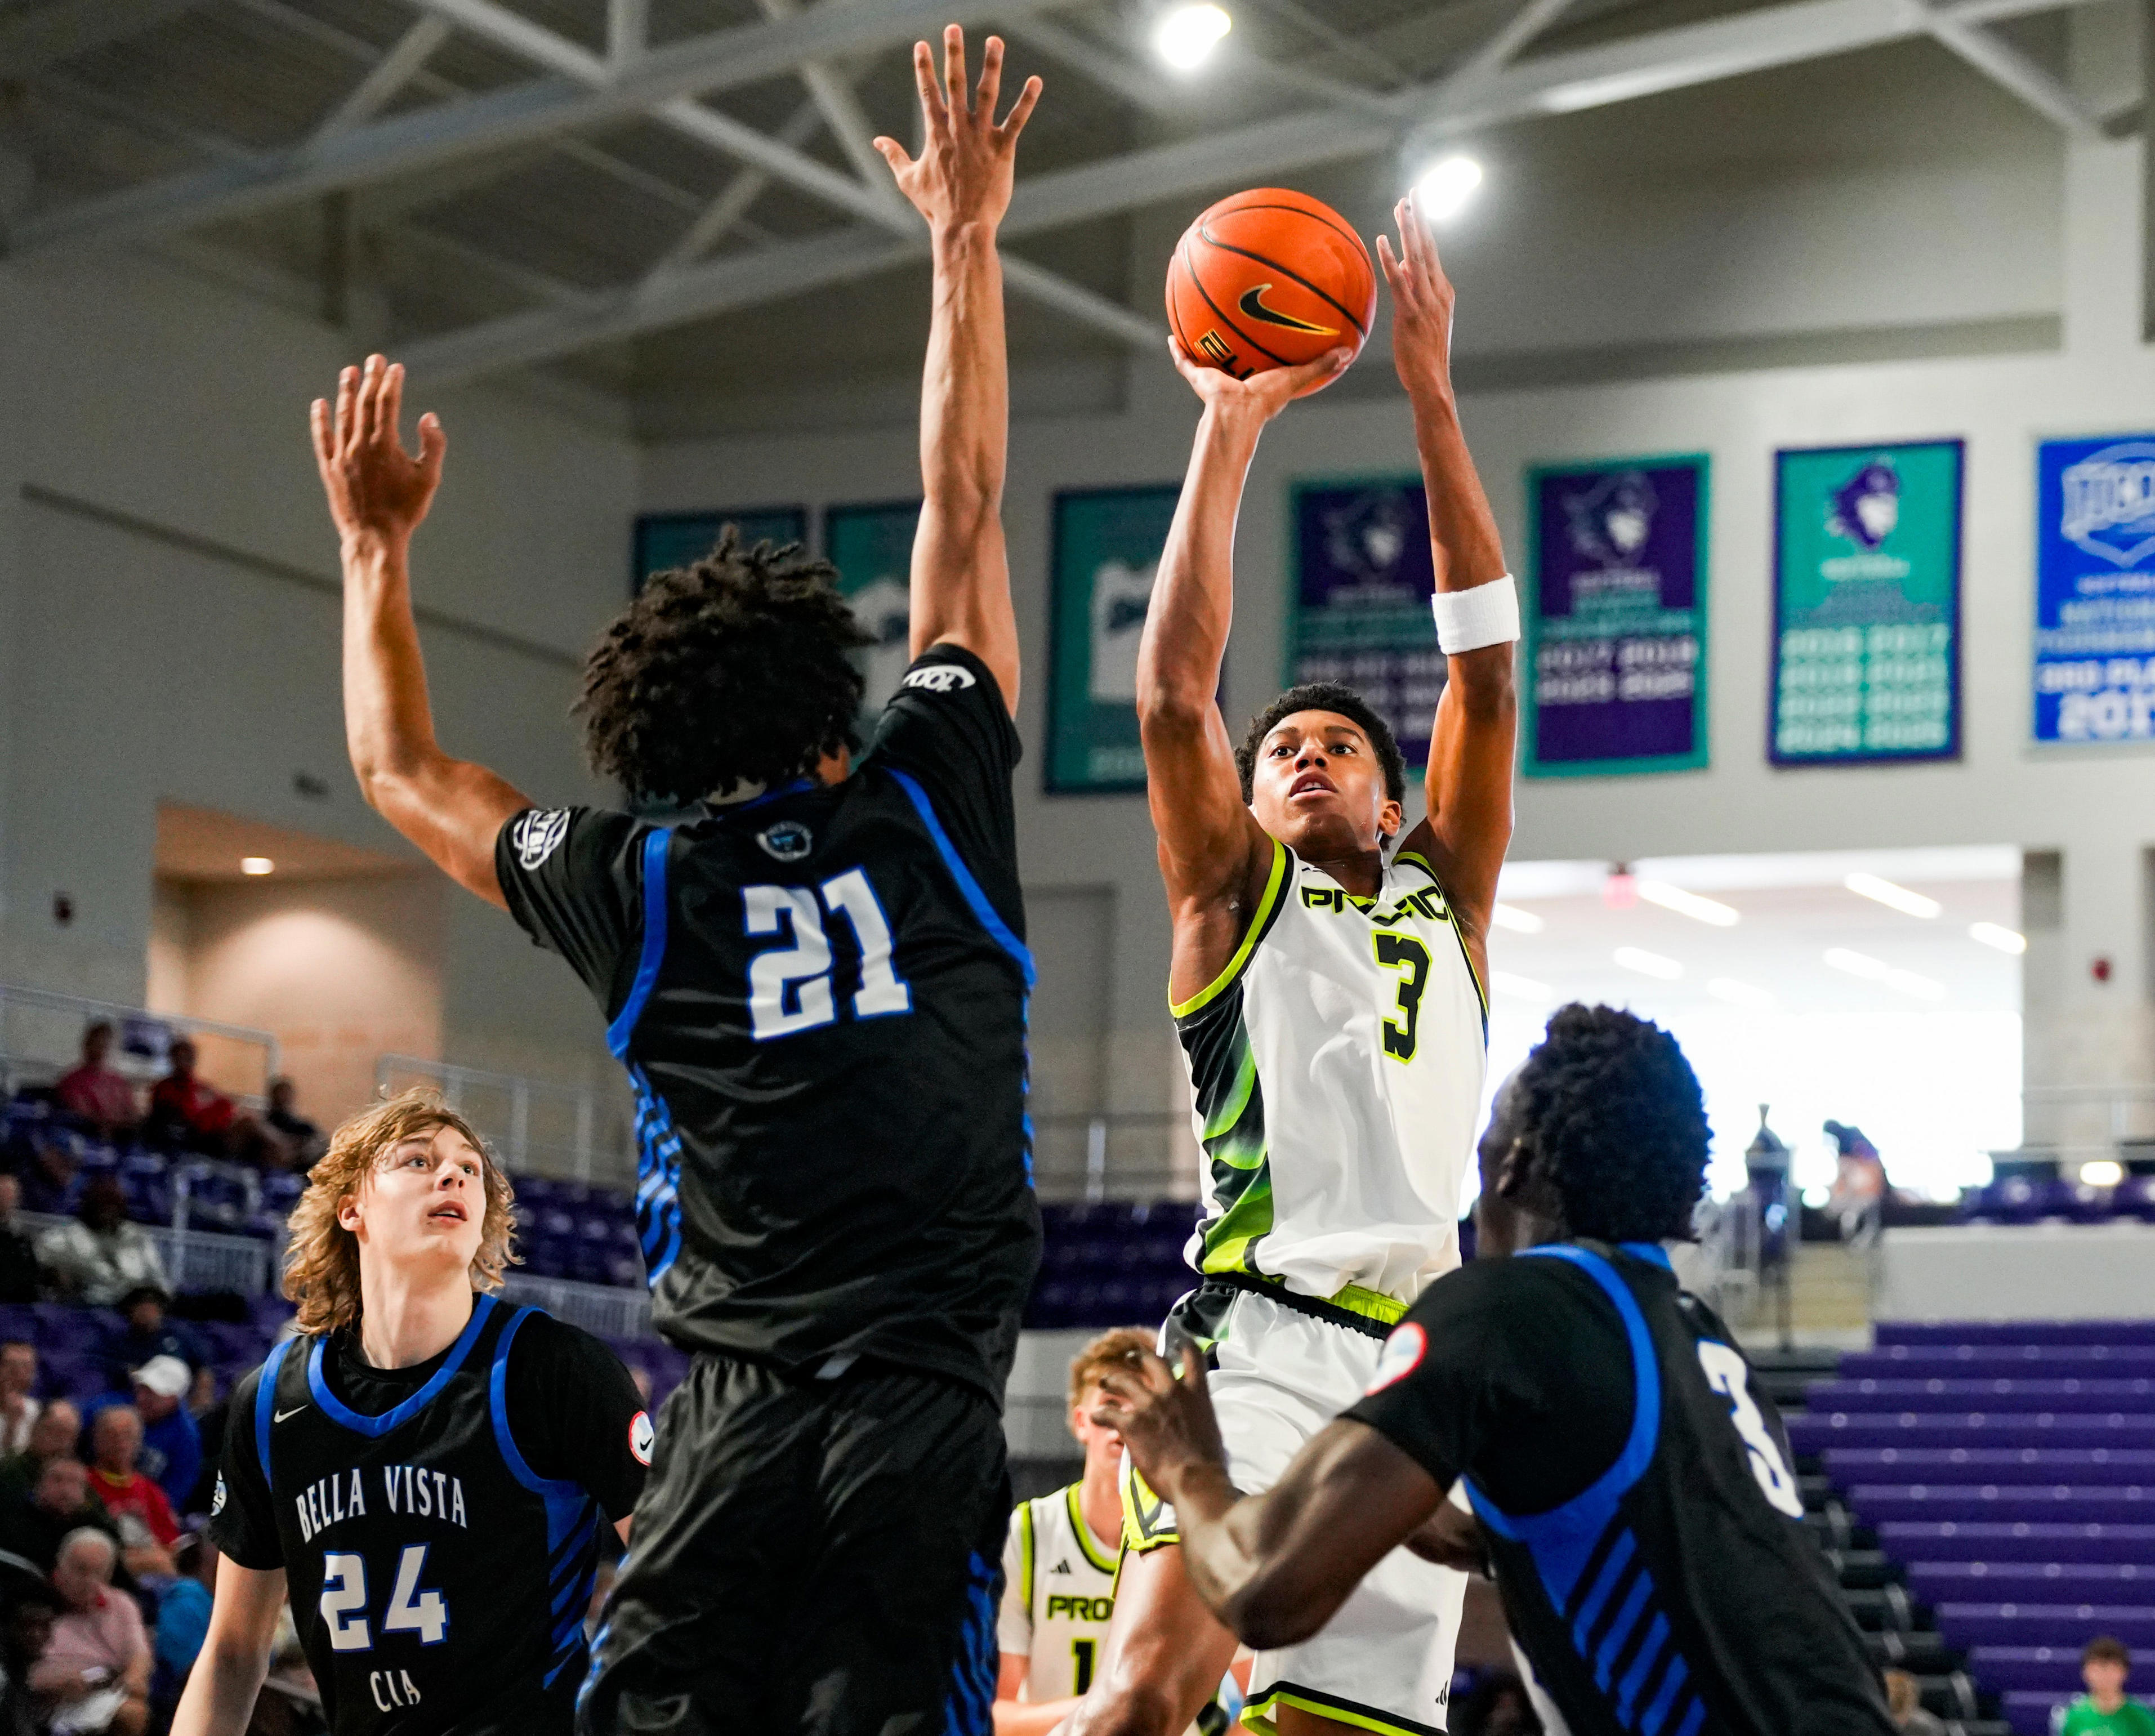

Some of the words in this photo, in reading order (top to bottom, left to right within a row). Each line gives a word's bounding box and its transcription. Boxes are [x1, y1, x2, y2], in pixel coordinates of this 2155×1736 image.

[2057, 690, 2155, 738] 201
[739, 864, 914, 1041] 21
[1371, 930, 1433, 1065] 3
[296, 1467, 367, 1543] BELLA
[383, 1465, 468, 1529] VISTA
[319, 1542, 450, 1653] 24
[1047, 1594, 1115, 1622] PRO
[369, 1668, 421, 1712] CIA
